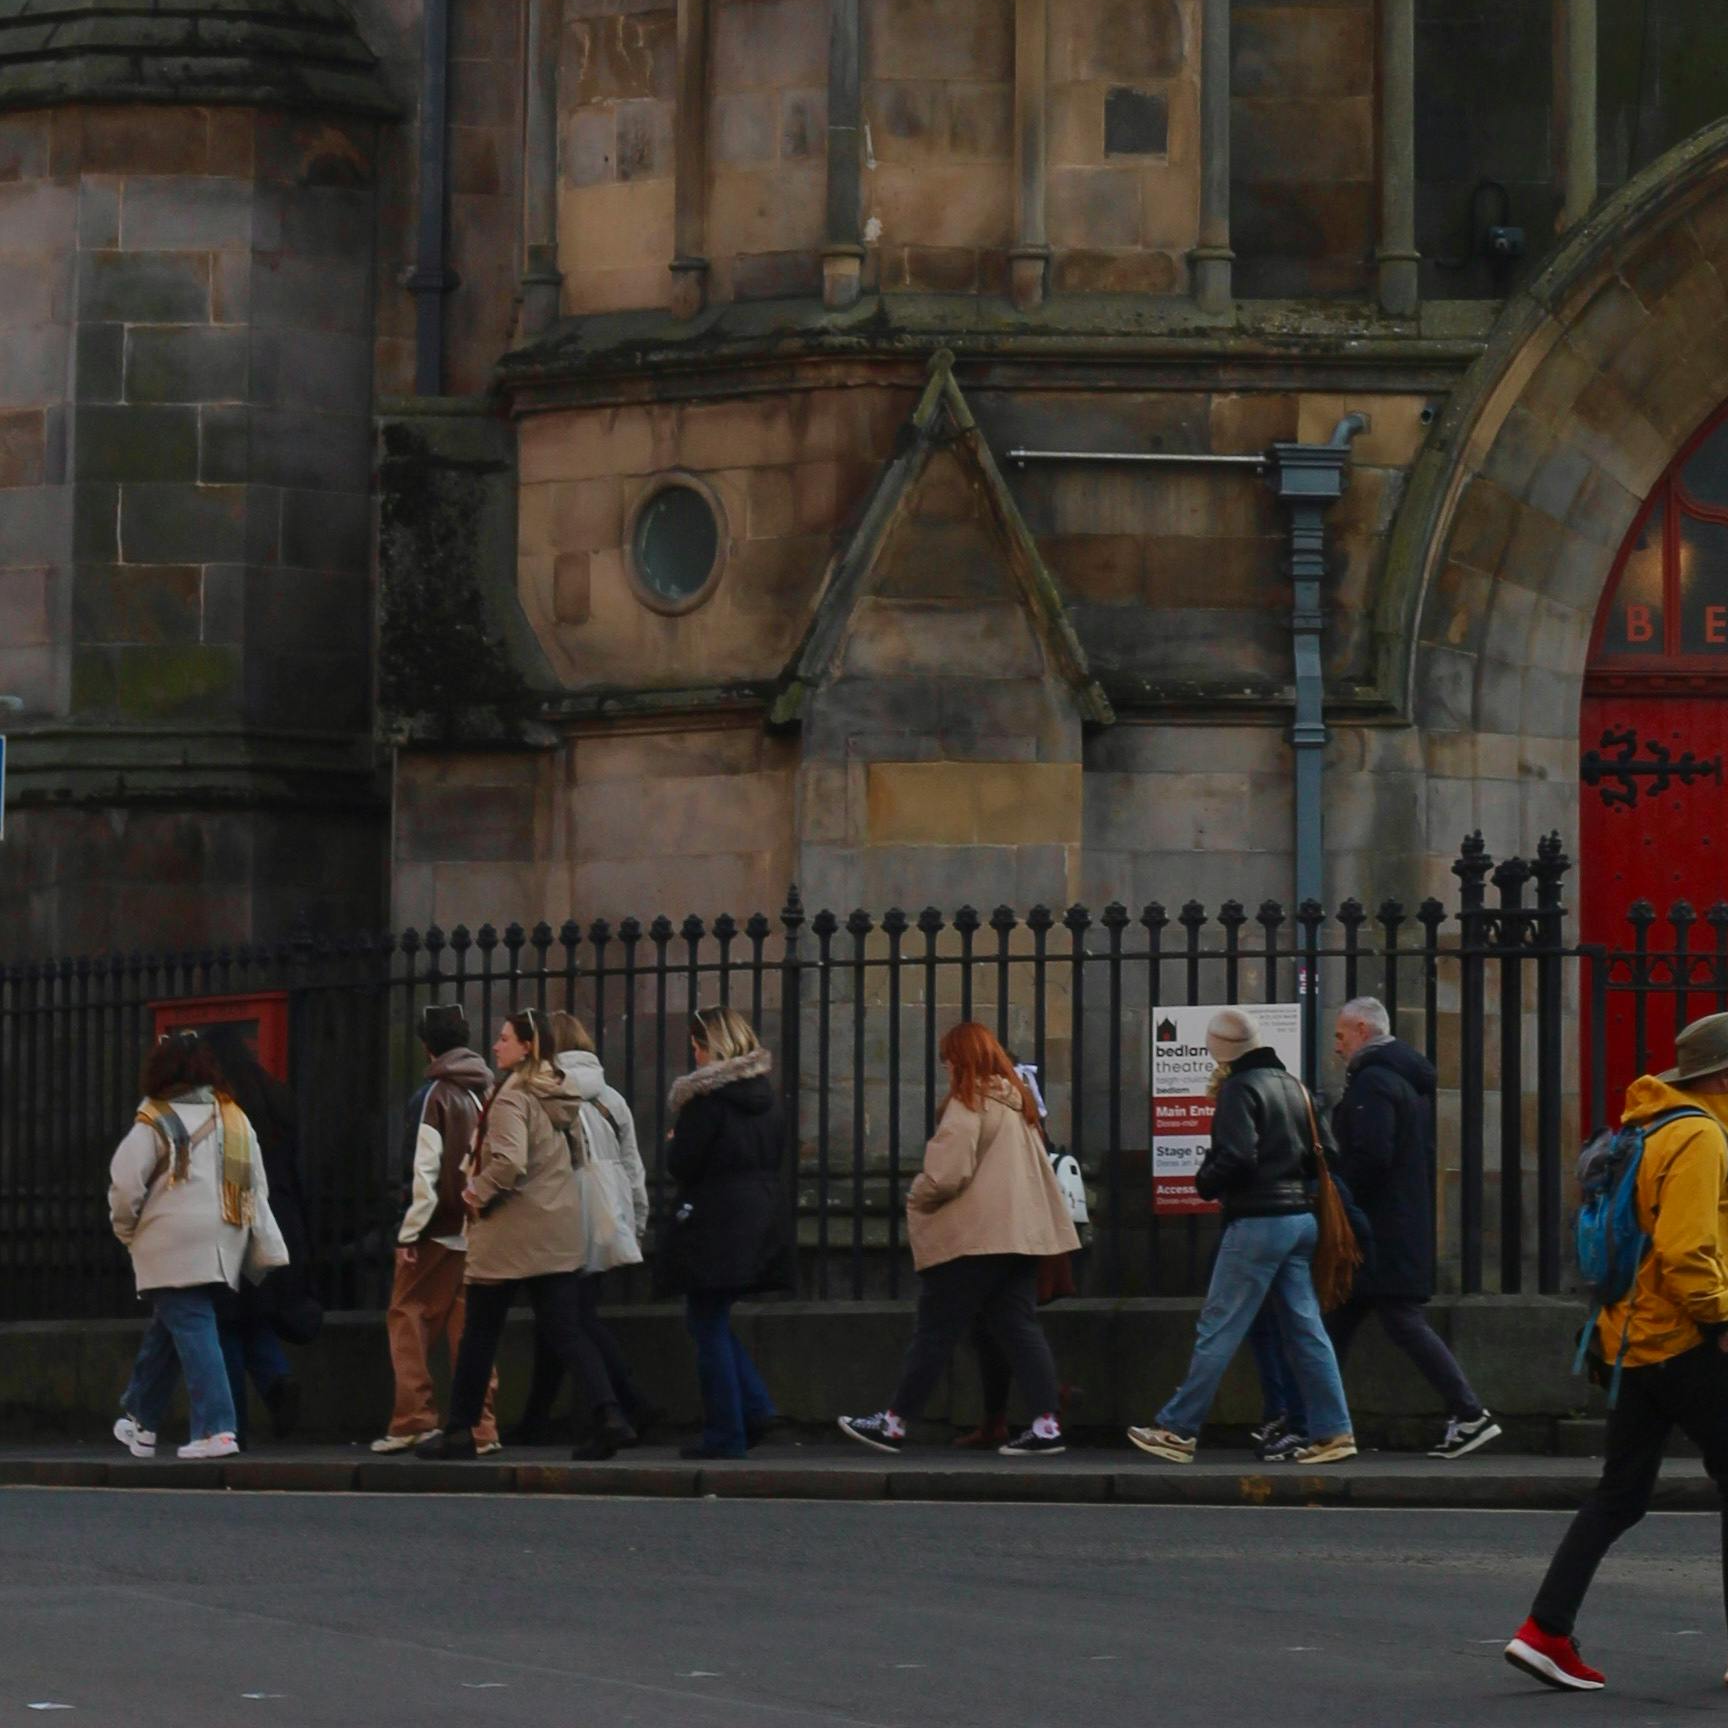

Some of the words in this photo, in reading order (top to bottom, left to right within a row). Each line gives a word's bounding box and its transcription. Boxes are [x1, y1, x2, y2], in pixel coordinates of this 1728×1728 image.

[1156, 1061, 1214, 1073] theatre
[1156, 1105, 1186, 1117] Main
[1190, 1105, 1216, 1116] Entr
[1156, 1146, 1192, 1159] Stage
